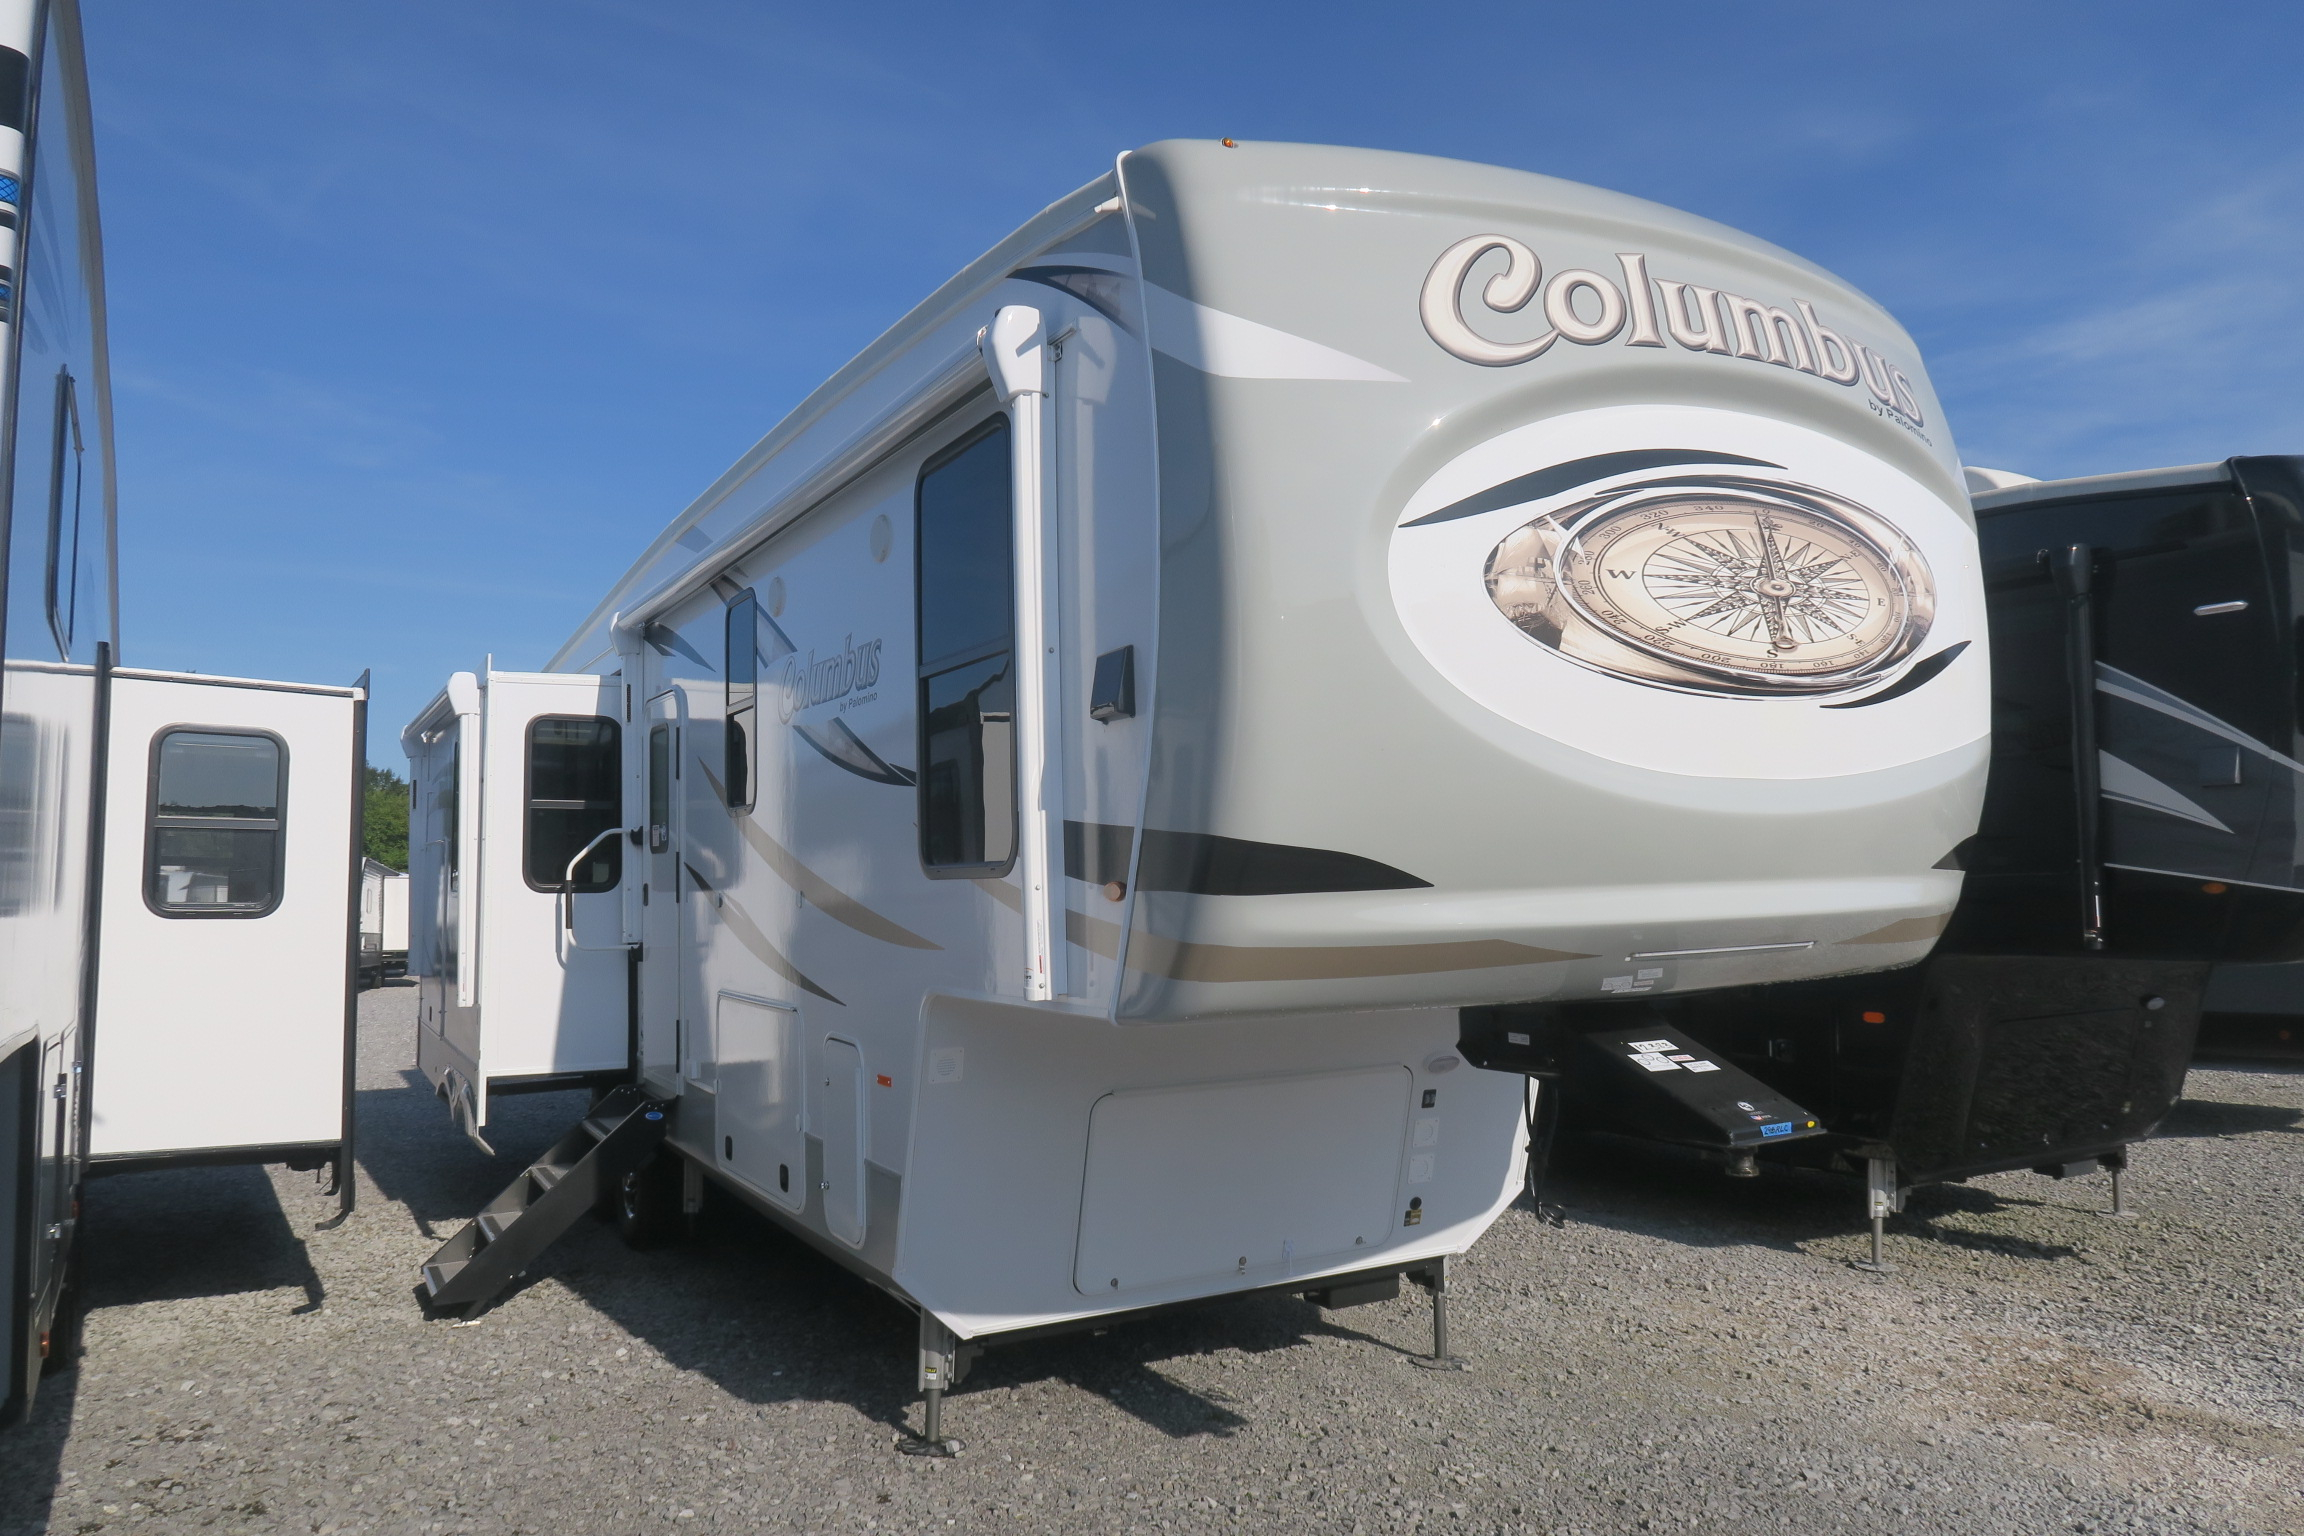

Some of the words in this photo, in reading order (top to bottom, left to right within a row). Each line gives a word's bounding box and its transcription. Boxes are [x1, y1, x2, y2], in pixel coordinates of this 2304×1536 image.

[1419, 233, 1924, 428] Columbus
[1868, 398, 1883, 417] by
[1886, 408, 1933, 447] Palomino
[1640, 509, 1669, 520] 320
[1599, 525, 1622, 540] 300
[1605, 568, 1637, 580] W
[1876, 597, 1886, 607] E
[1766, 648, 1779, 659] S
[778, 632, 882, 726] Columbus
[839, 700, 847, 713] by
[848, 691, 878, 710] Palomino
